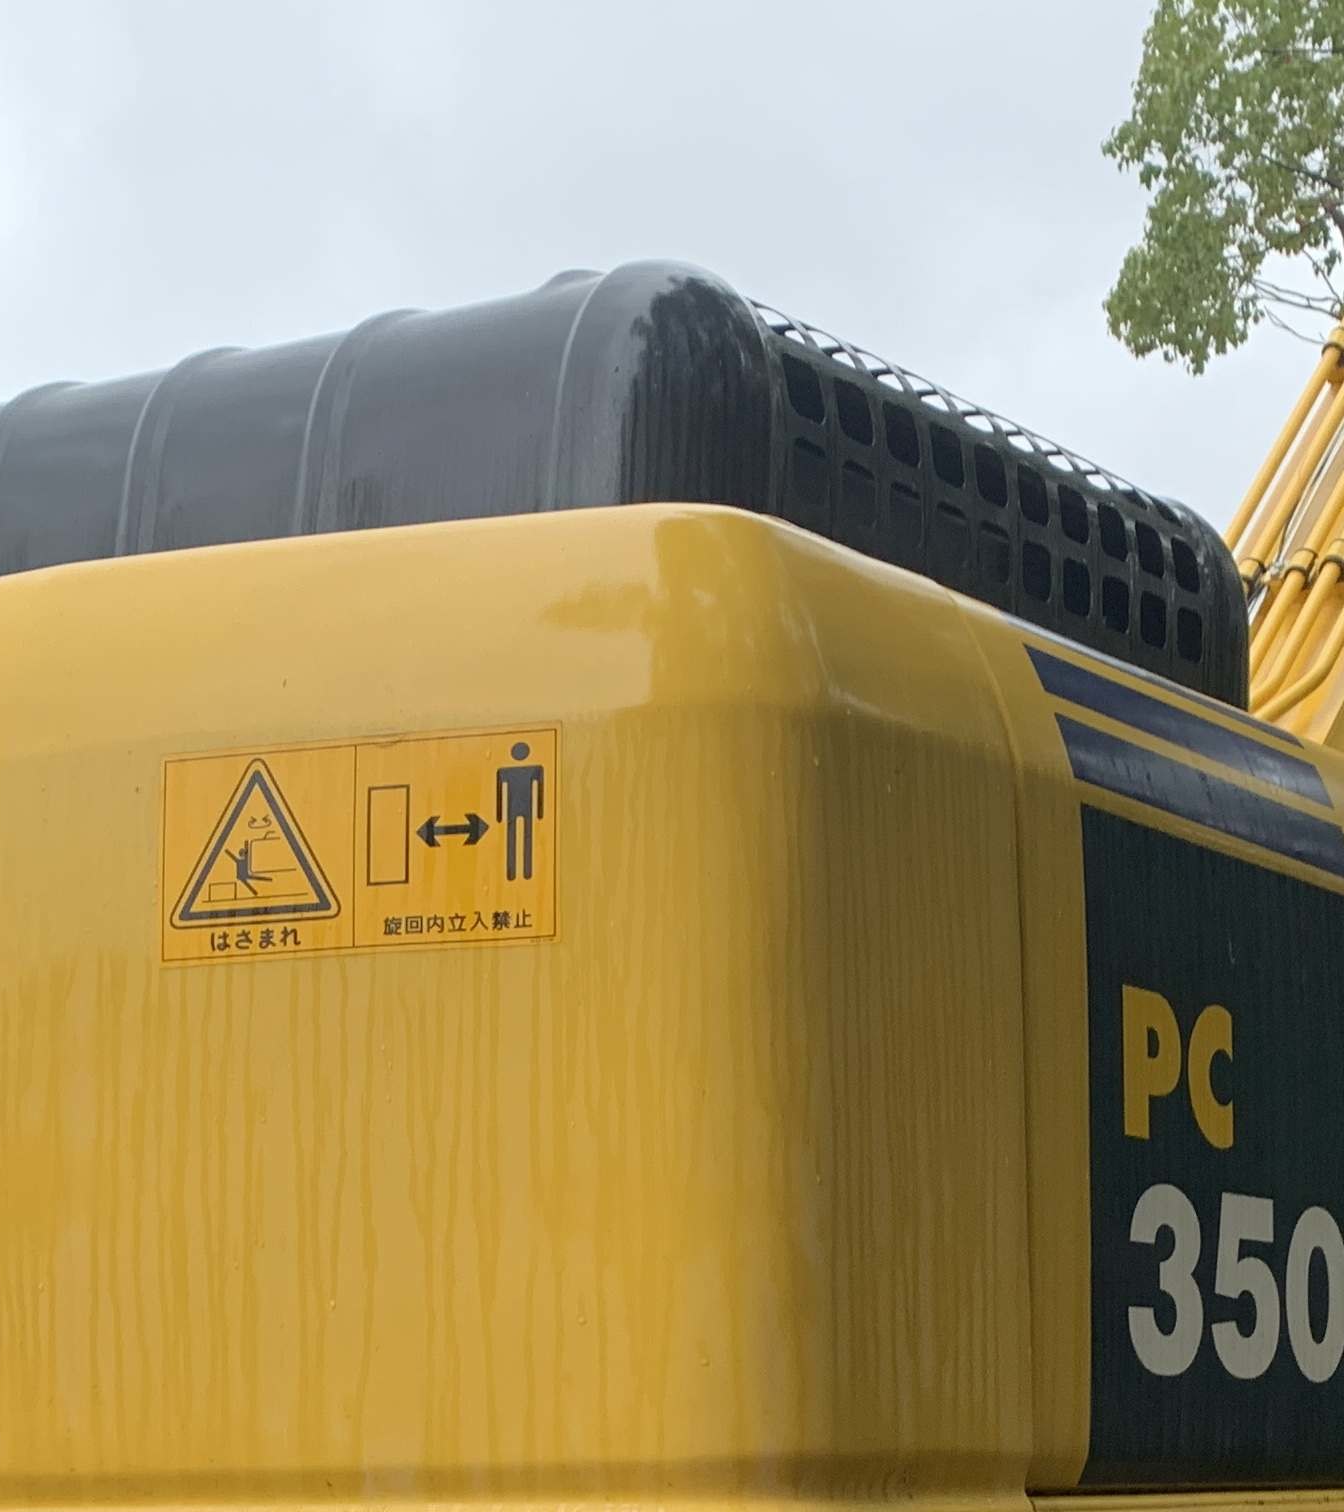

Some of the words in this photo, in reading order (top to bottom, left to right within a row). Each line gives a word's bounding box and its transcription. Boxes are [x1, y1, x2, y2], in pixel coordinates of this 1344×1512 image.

[383, 909, 533, 936] 旋回内立入禁止
[210, 926, 302, 952] はさまれ
[1121, 983, 1235, 1150] PC
